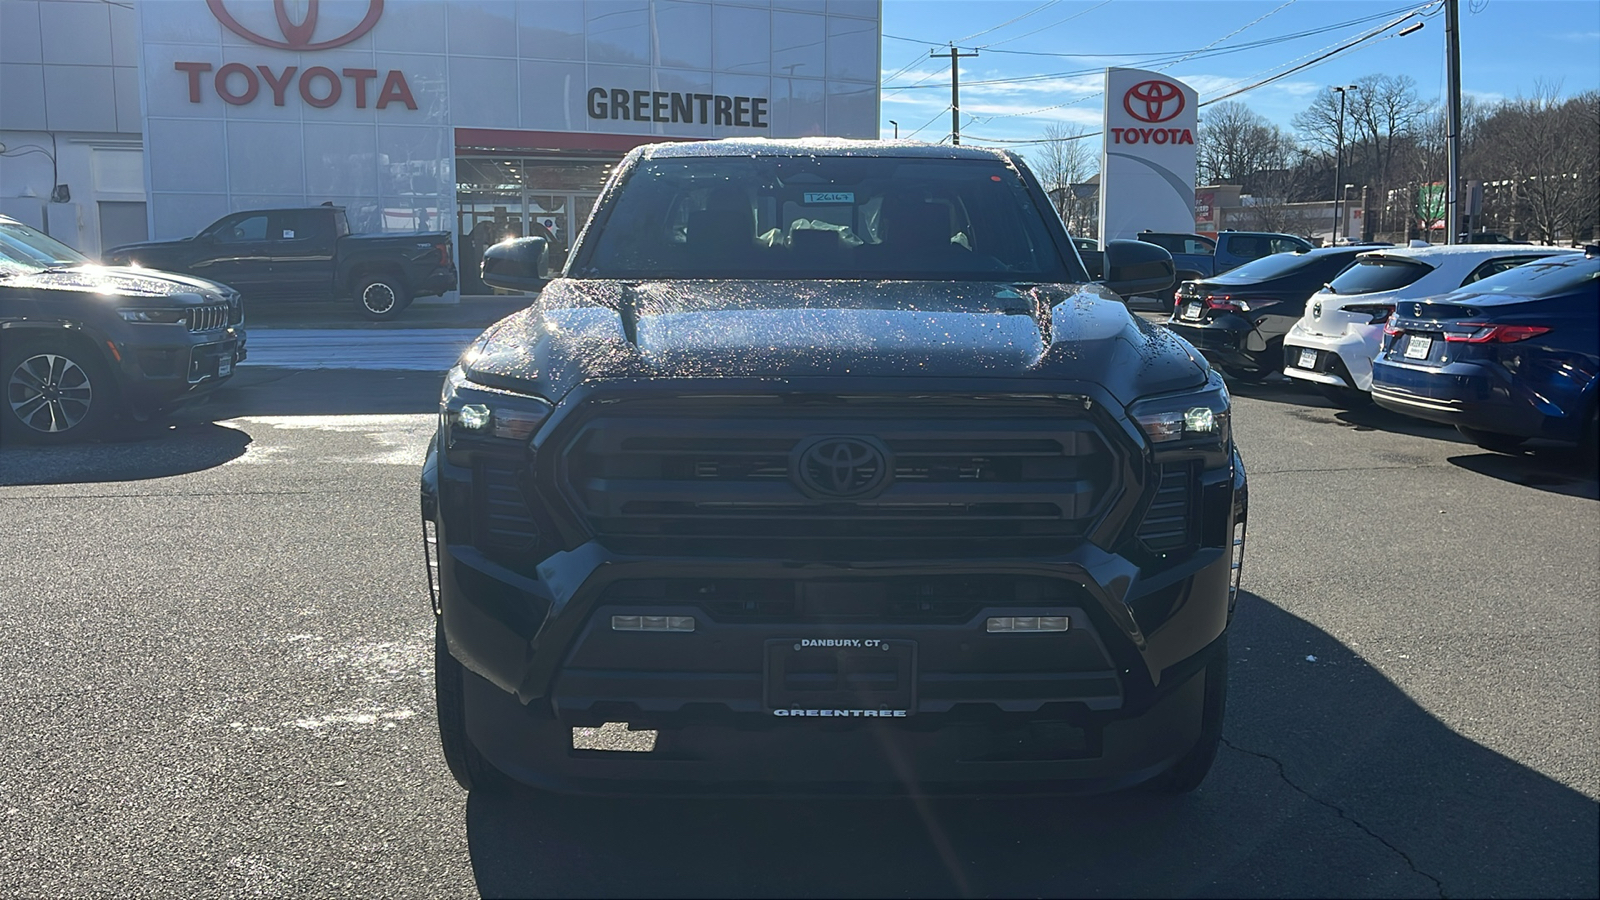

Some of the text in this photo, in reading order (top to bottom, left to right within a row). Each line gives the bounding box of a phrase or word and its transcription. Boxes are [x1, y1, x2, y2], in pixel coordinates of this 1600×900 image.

[174, 61, 419, 110] TOYOTA
[587, 87, 768, 128] GREENTREE
[1110, 127, 1194, 145] TOYOTA
[801, 639, 881, 648] DANBURY, CT
[773, 709, 907, 717] GREENTREE
